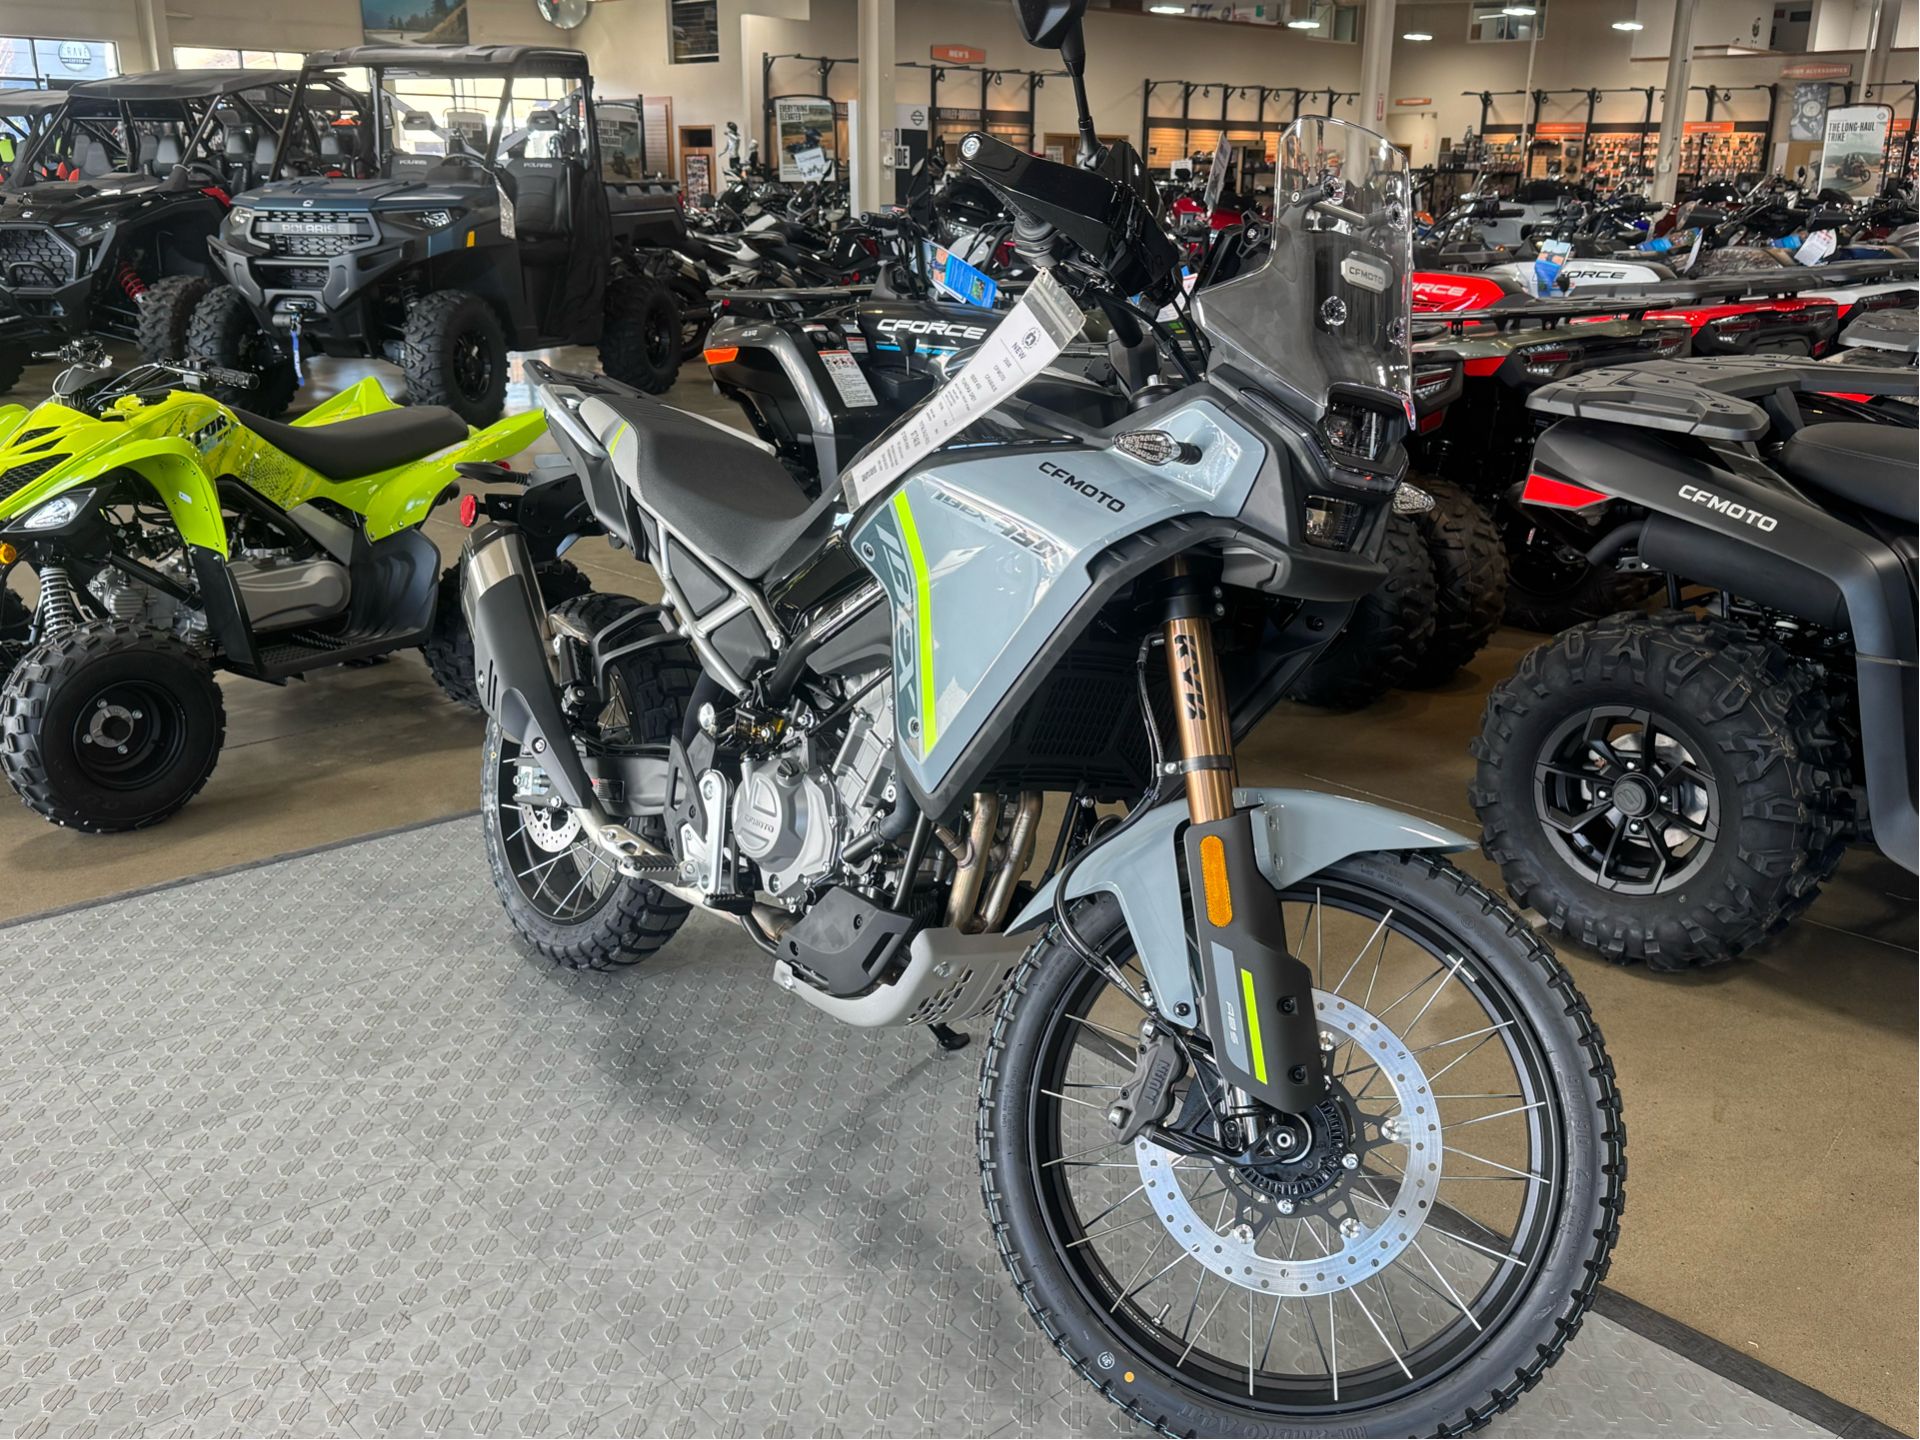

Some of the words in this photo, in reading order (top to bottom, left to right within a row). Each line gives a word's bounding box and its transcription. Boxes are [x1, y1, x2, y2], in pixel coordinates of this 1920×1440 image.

[1829, 122, 1841, 133] THE
[1841, 121, 1875, 133] LONG-HAUL
[1828, 132, 1846, 143] TRIKE
[523, 161, 553, 169] POLARIS
[281, 223, 336, 234] POLARIS
[1348, 266, 1384, 285] CFMOTO
[877, 318, 987, 340] CFORCE
[1009, 341, 1027, 360] NEW
[1038, 461, 1126, 513] CFMOTO
[1677, 484, 1778, 533] CFMOTO
